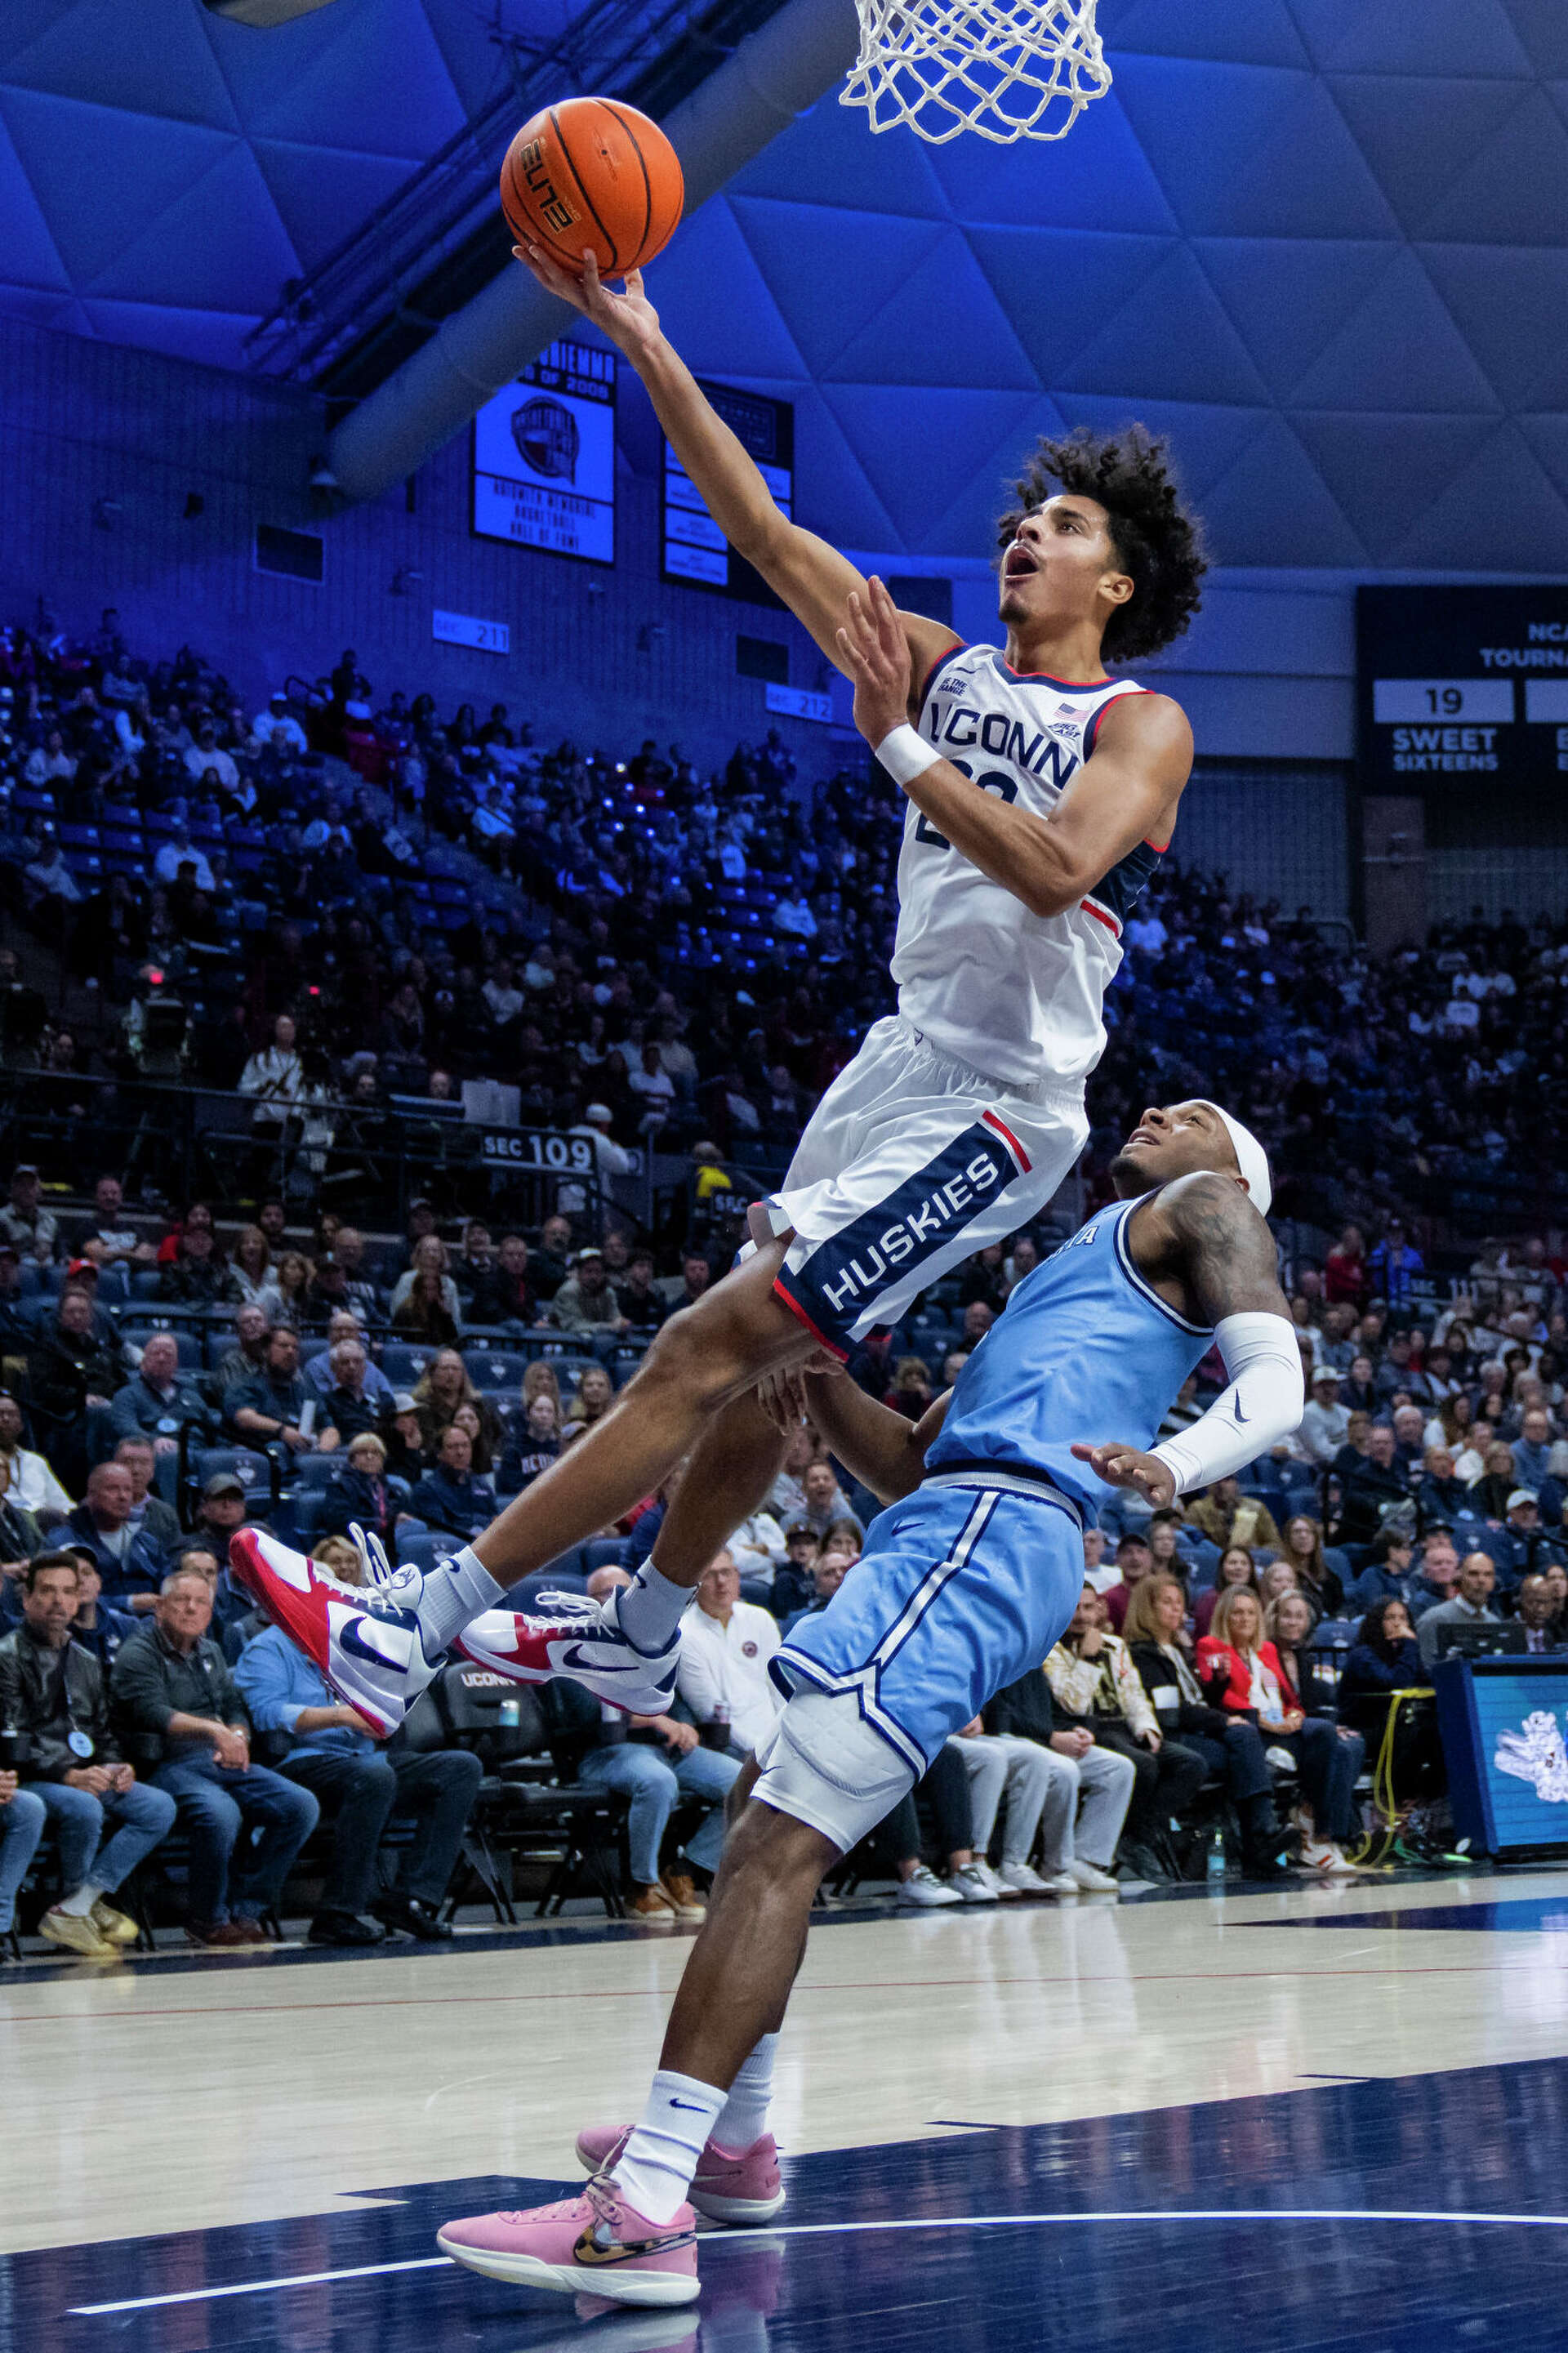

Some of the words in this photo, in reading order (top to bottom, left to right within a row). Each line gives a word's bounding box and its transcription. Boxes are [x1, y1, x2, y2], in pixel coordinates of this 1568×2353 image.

[521, 138, 574, 234] ELITE
[477, 625, 507, 648] 211
[951, 678, 968, 689] THE
[1426, 689, 1463, 715] 19
[1392, 728, 1498, 751] SWEET
[1393, 752, 1498, 771] SIXTEENS
[484, 1136, 523, 1157] SEC
[530, 1134, 591, 1170] 109
[822, 1152, 1000, 1312] HUSKIES
